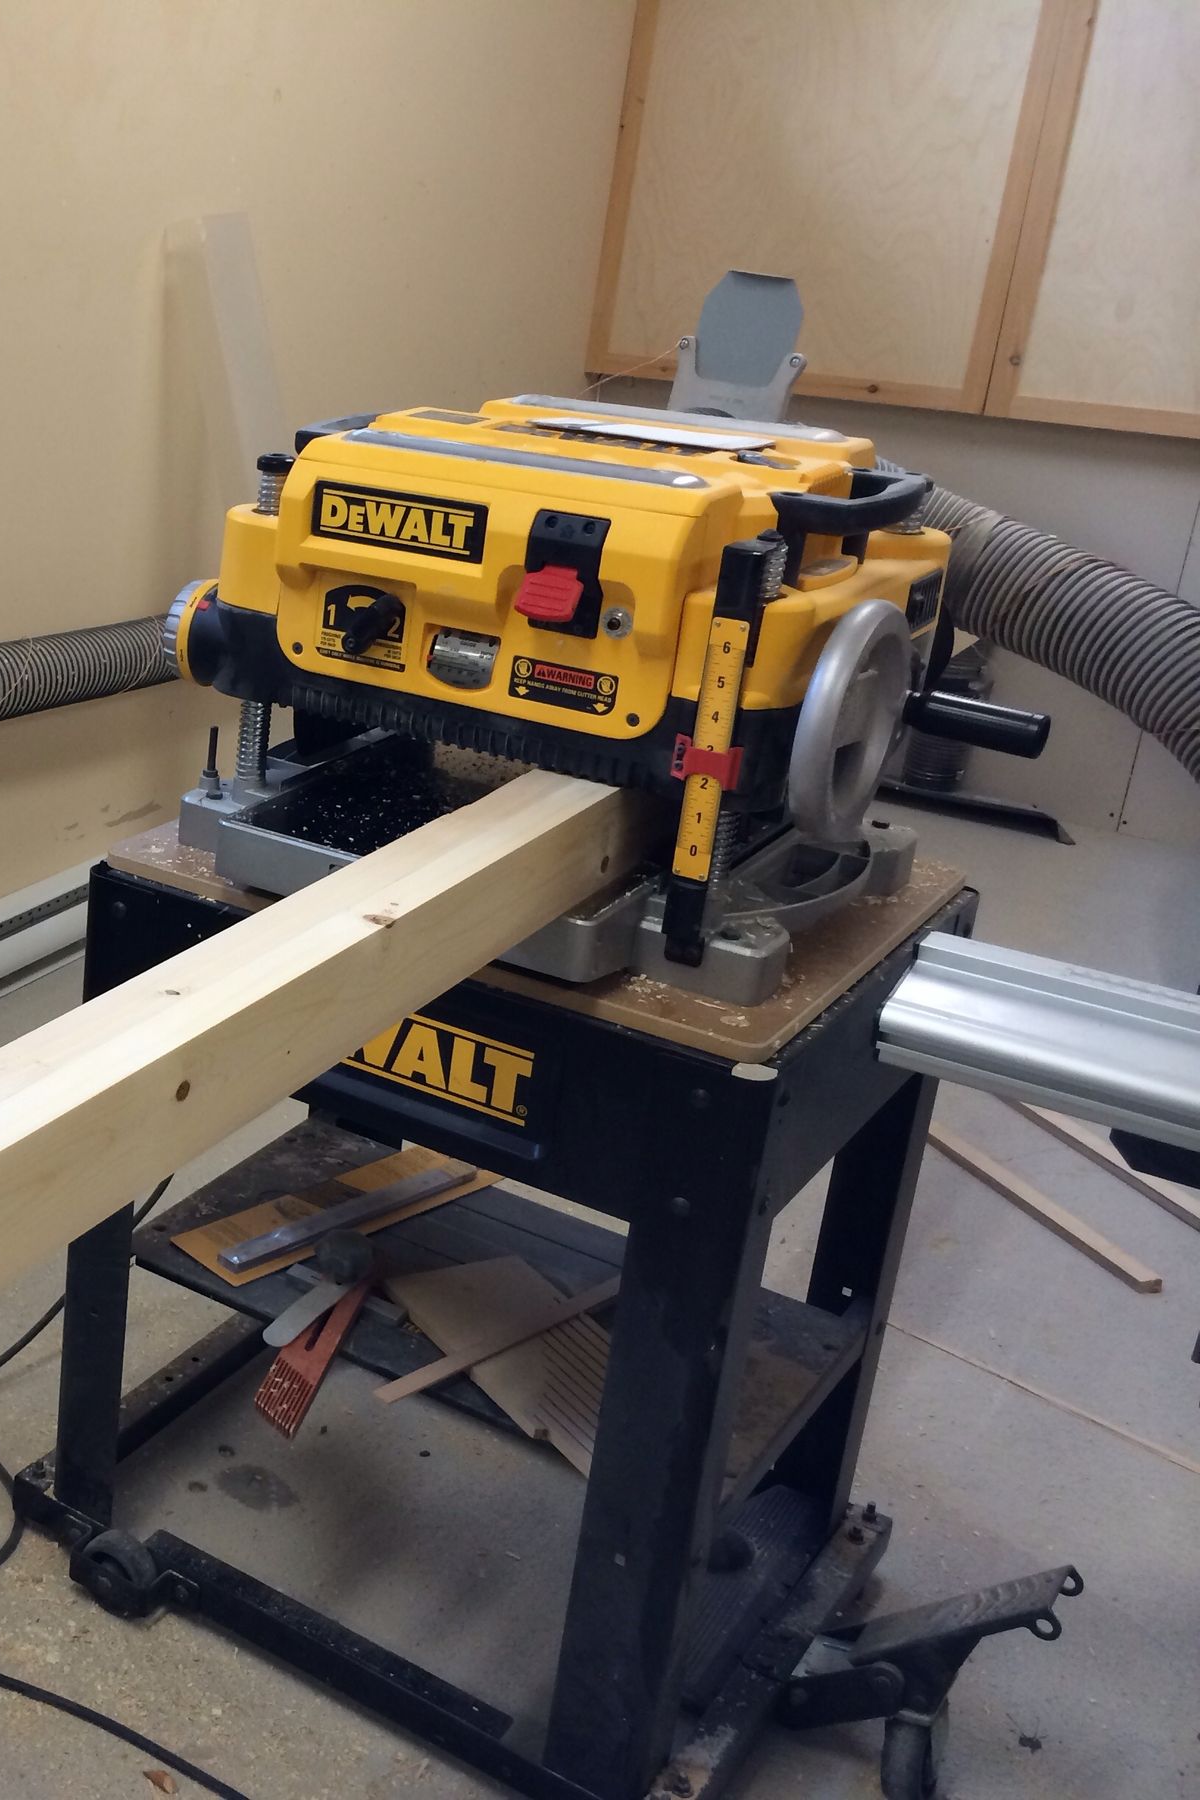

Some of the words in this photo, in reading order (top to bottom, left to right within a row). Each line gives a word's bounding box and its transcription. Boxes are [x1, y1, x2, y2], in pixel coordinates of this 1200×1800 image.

[327, 604, 336, 626] 1
[387, 617, 401, 639] 2
[722, 641, 731, 654] 6
[547, 667, 593, 688] WARNING
[717, 676, 725, 689] 5
[513, 677, 526, 685] KEEP
[527, 680, 545, 689] HANDS
[545, 684, 562, 693] AWAY
[562, 687, 577, 697] FROM
[577, 690, 597, 700] CUTTER
[597, 694, 612, 703] HEAD
[712, 711, 720, 723] 4
[700, 777, 709, 790] 2
[696, 812, 702, 824] 1
[689, 844, 698, 857] 0
